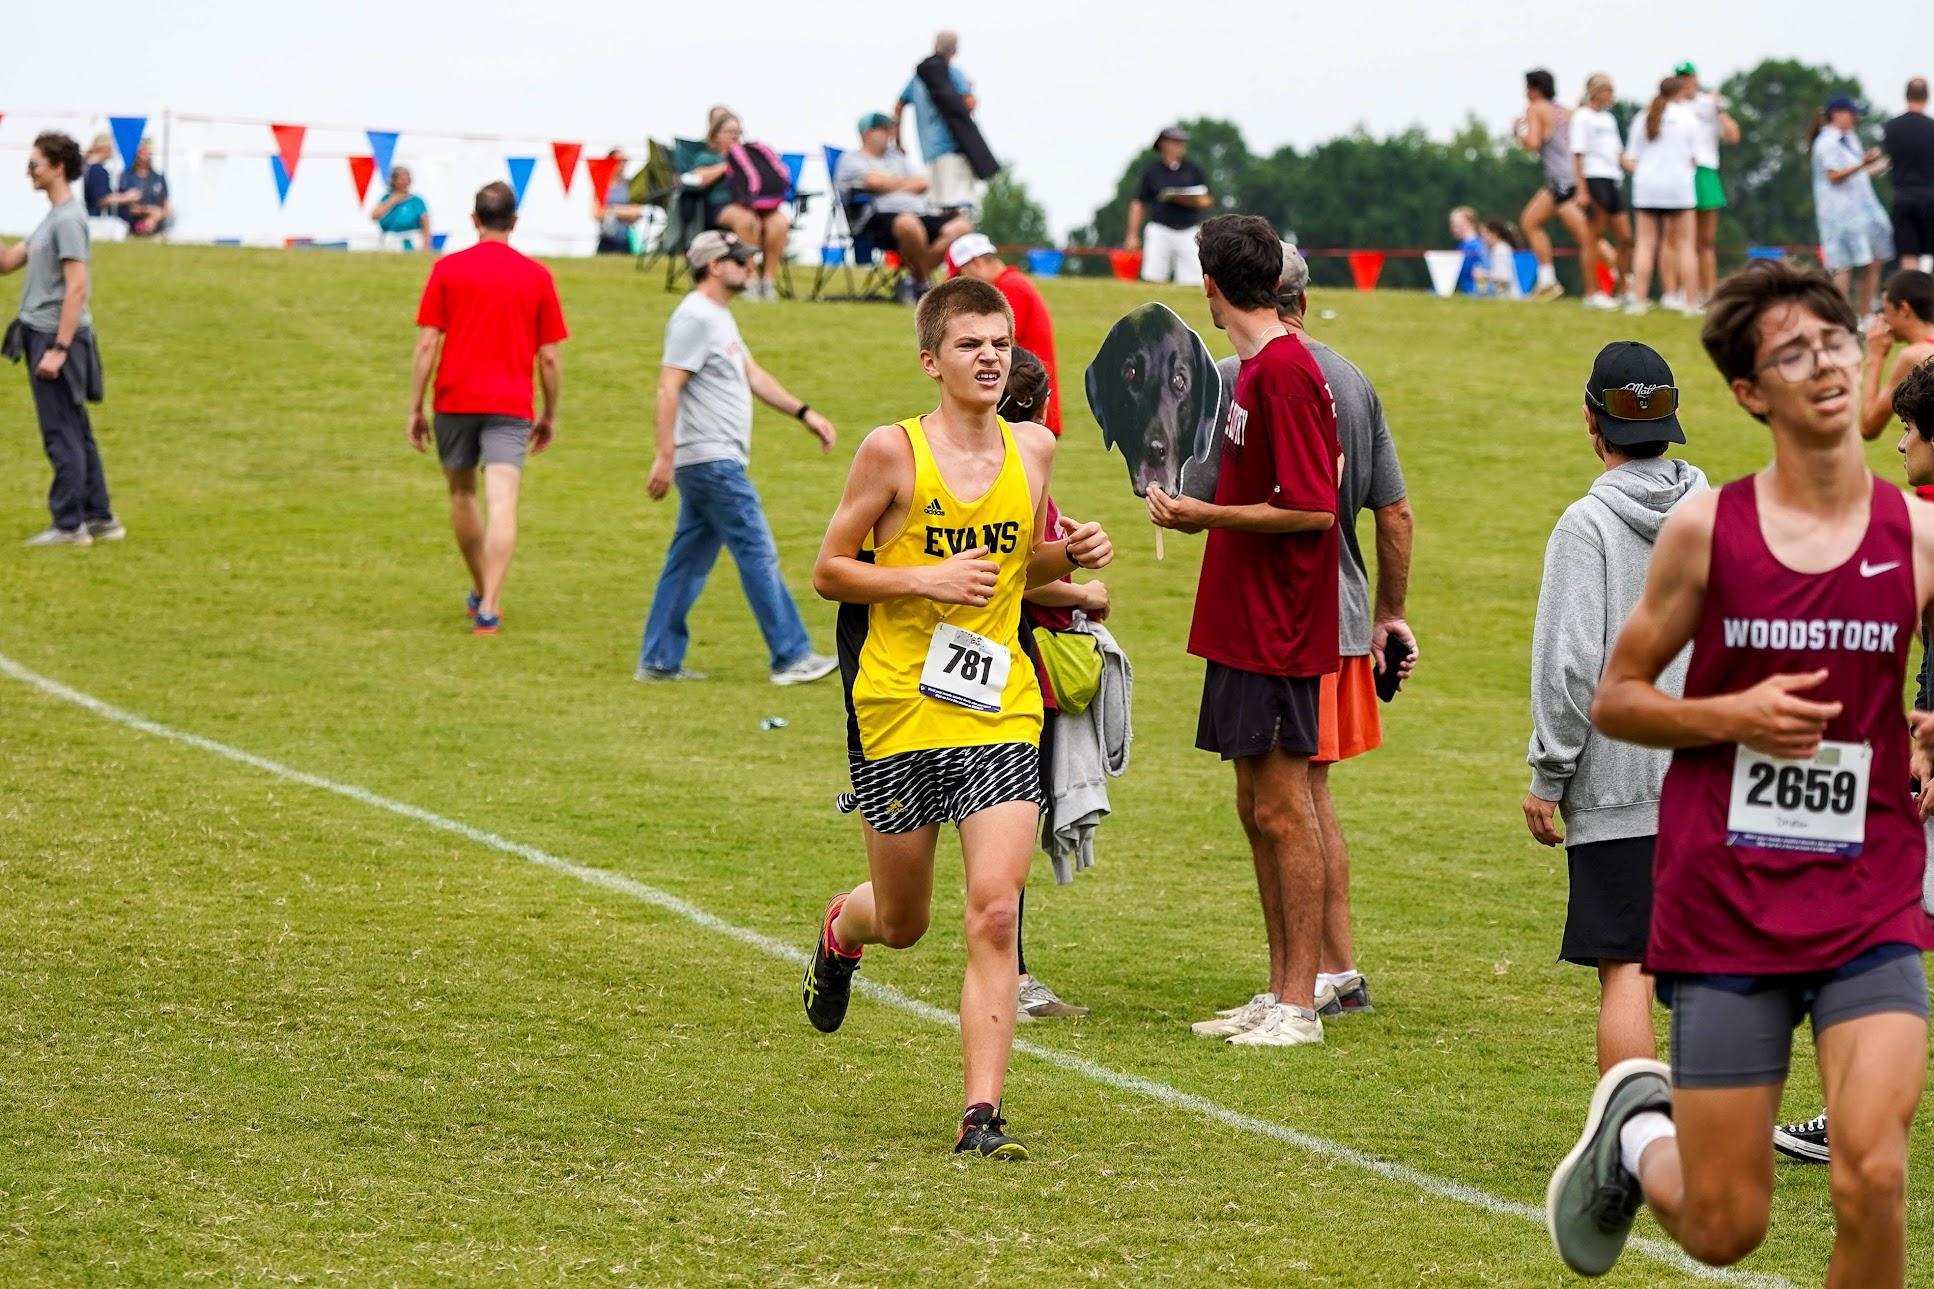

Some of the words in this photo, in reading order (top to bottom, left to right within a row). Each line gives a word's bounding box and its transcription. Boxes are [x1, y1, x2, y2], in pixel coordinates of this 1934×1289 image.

[924, 521, 1019, 558] EVANS
[1723, 617, 1898, 652] WOODSTOCK
[943, 643, 993, 685] 781
[1746, 762, 1856, 814] 2659
